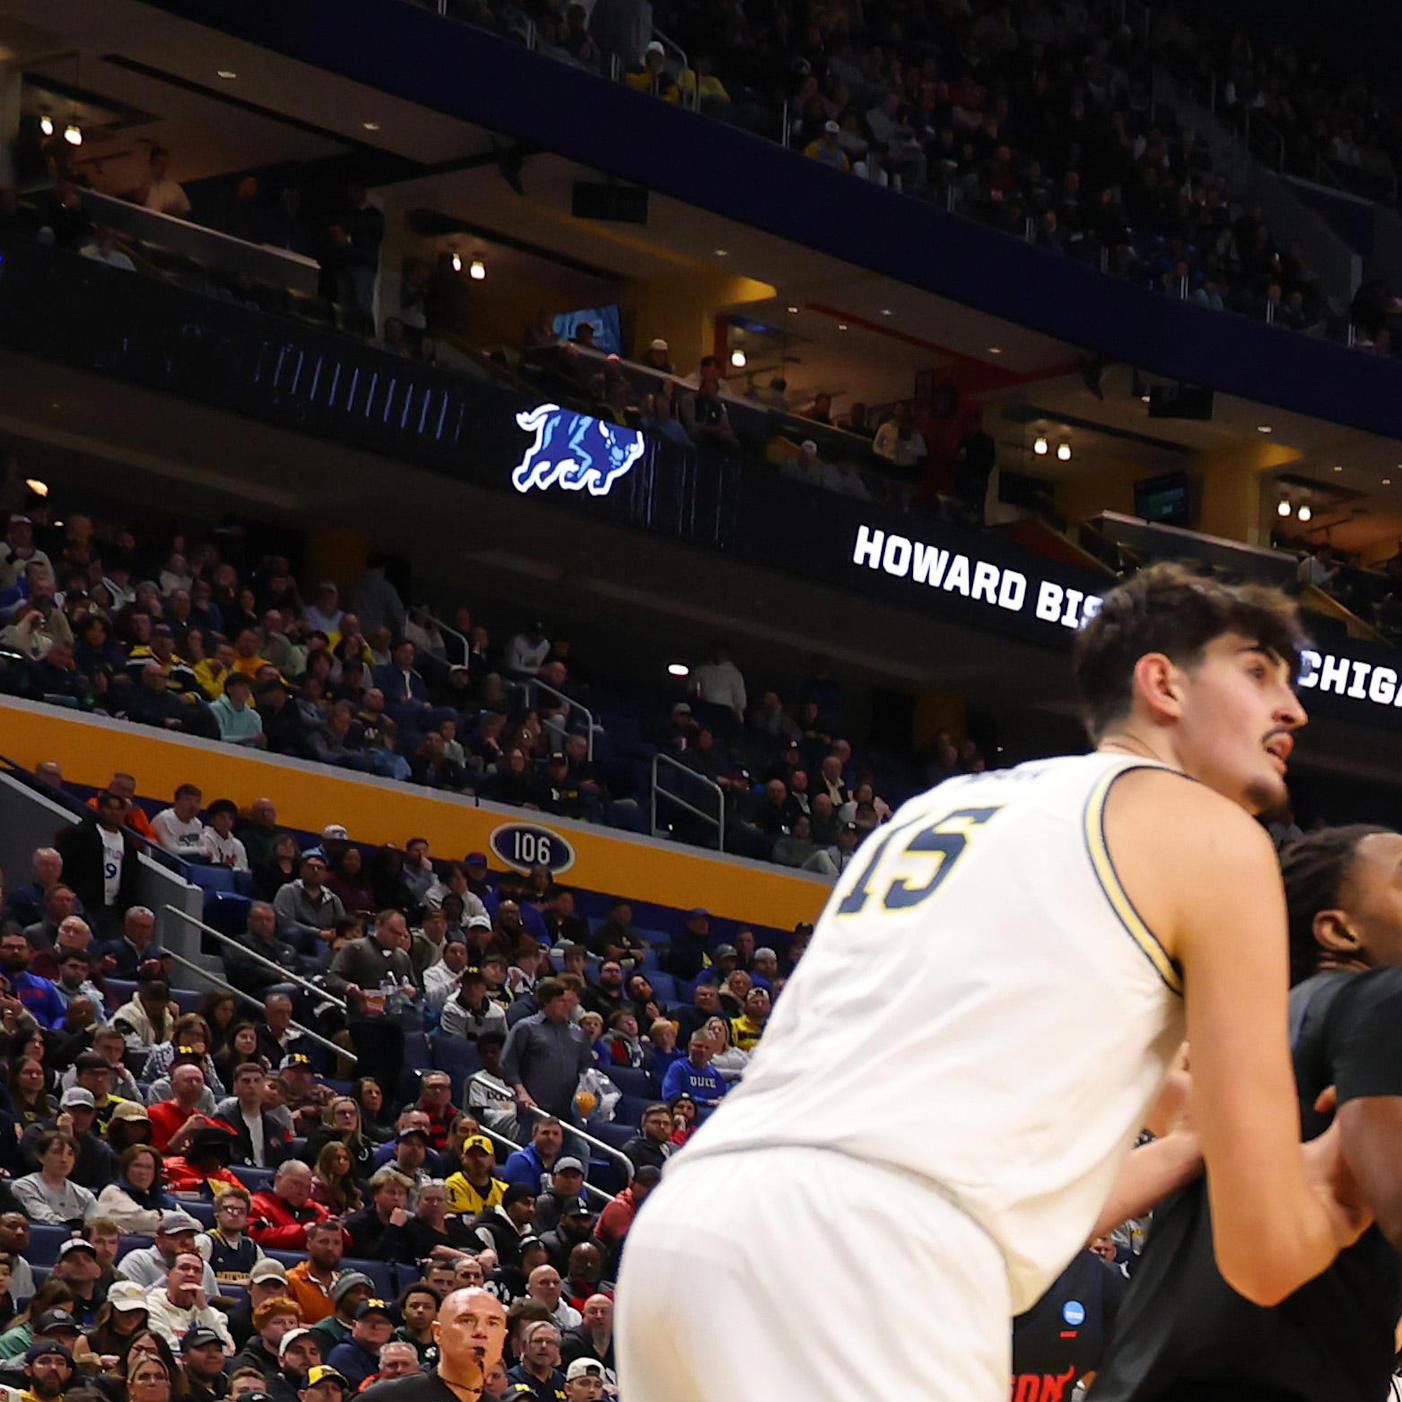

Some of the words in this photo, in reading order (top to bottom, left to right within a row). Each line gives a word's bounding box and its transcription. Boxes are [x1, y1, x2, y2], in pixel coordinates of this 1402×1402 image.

[853, 524, 1027, 612] HOWARD
[1035, 580, 1104, 630] BIS
[513, 830, 552, 866] 106
[834, 805, 1006, 918] 15
